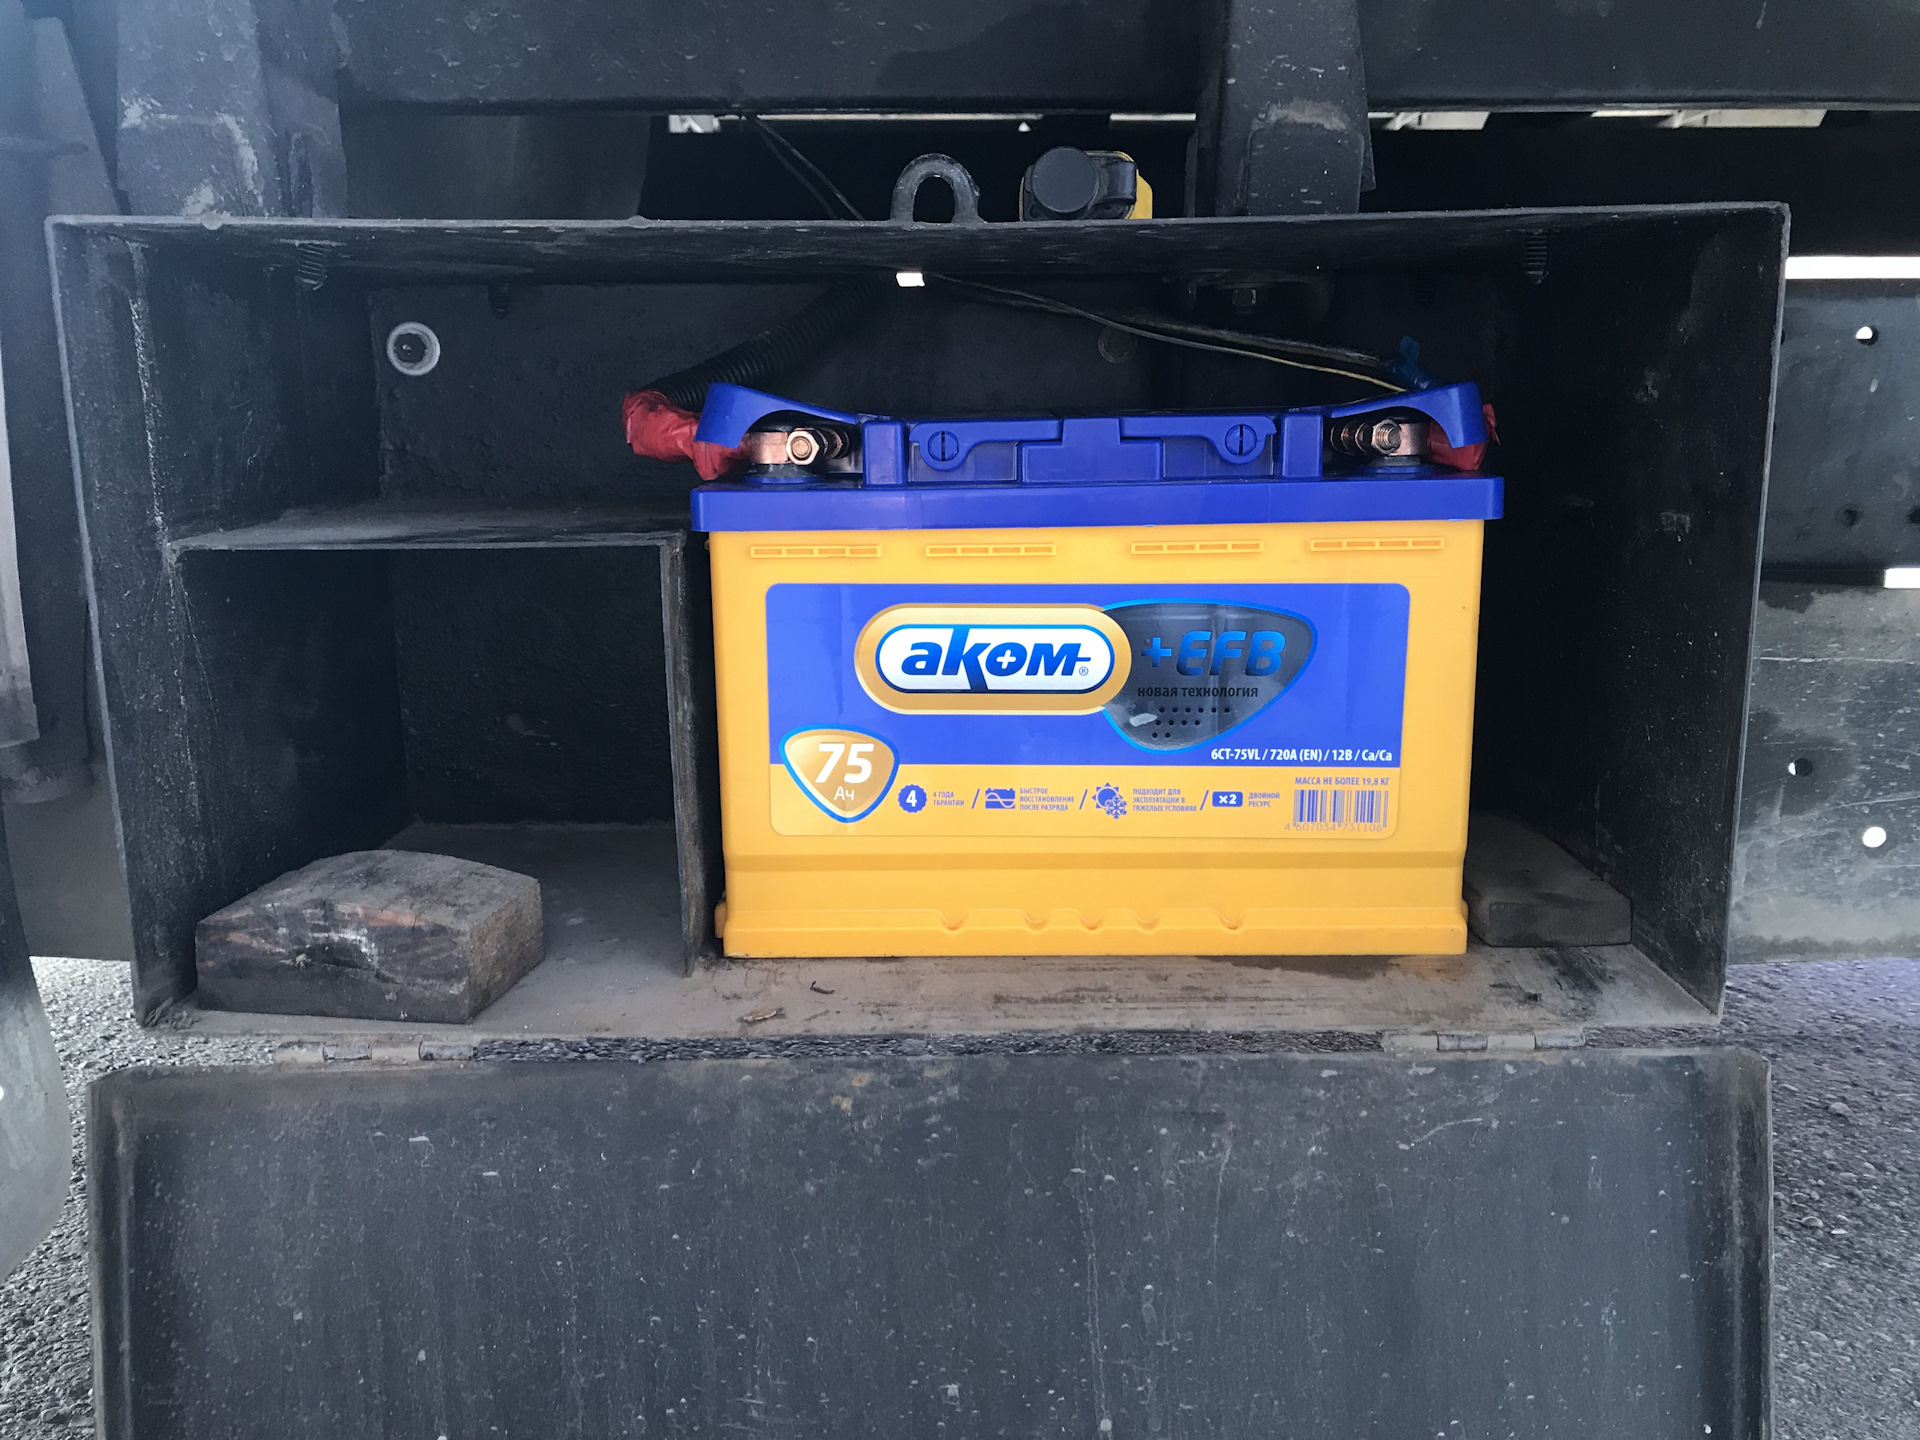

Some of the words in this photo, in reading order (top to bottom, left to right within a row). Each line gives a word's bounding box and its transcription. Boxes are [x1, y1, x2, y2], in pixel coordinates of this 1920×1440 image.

[1137, 686, 1178, 697] новая
[1181, 687, 1258, 698] технология
[1299, 749, 1322, 762] (EN)
[815, 743, 874, 783] 75
[1335, 777, 1359, 785] БОЛЕЕ
[1362, 778, 1379, 786] 19,8
[834, 786, 855, 801] Ач
[906, 790, 917, 807] 4
